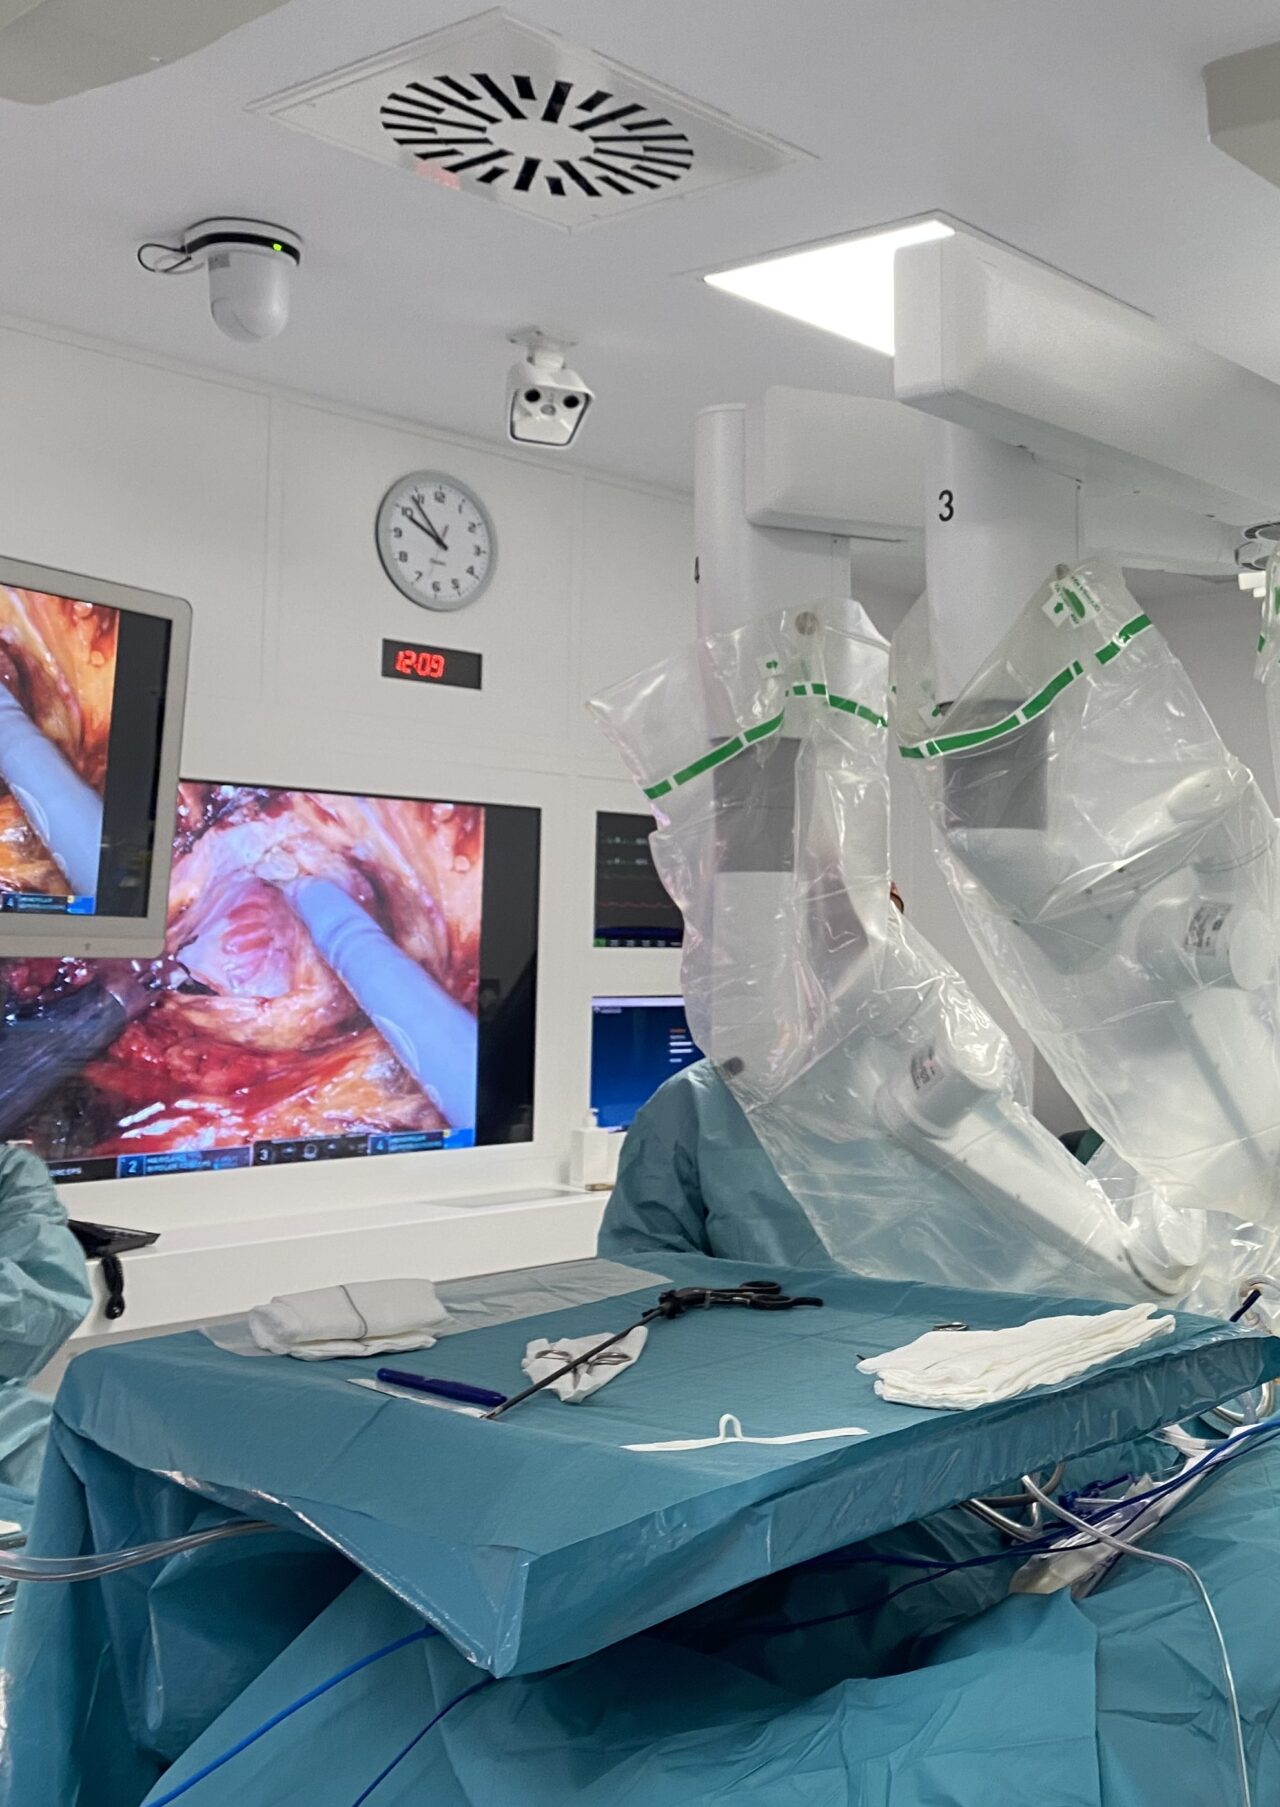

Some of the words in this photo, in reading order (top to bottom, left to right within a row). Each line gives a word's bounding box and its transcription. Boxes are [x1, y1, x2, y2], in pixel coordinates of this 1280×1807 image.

[434, 491, 446, 504] 12
[938, 489, 954, 521] 3
[401, 506, 414, 518] 10
[393, 527, 403, 539] 9
[468, 521, 477, 533] 2
[474, 544, 481, 557] 3
[398, 551, 408, 563] 8
[414, 570, 423, 582] 7
[466, 565, 475, 577] 4
[432, 581, 441, 593] 6
[451, 578, 460, 590] 5
